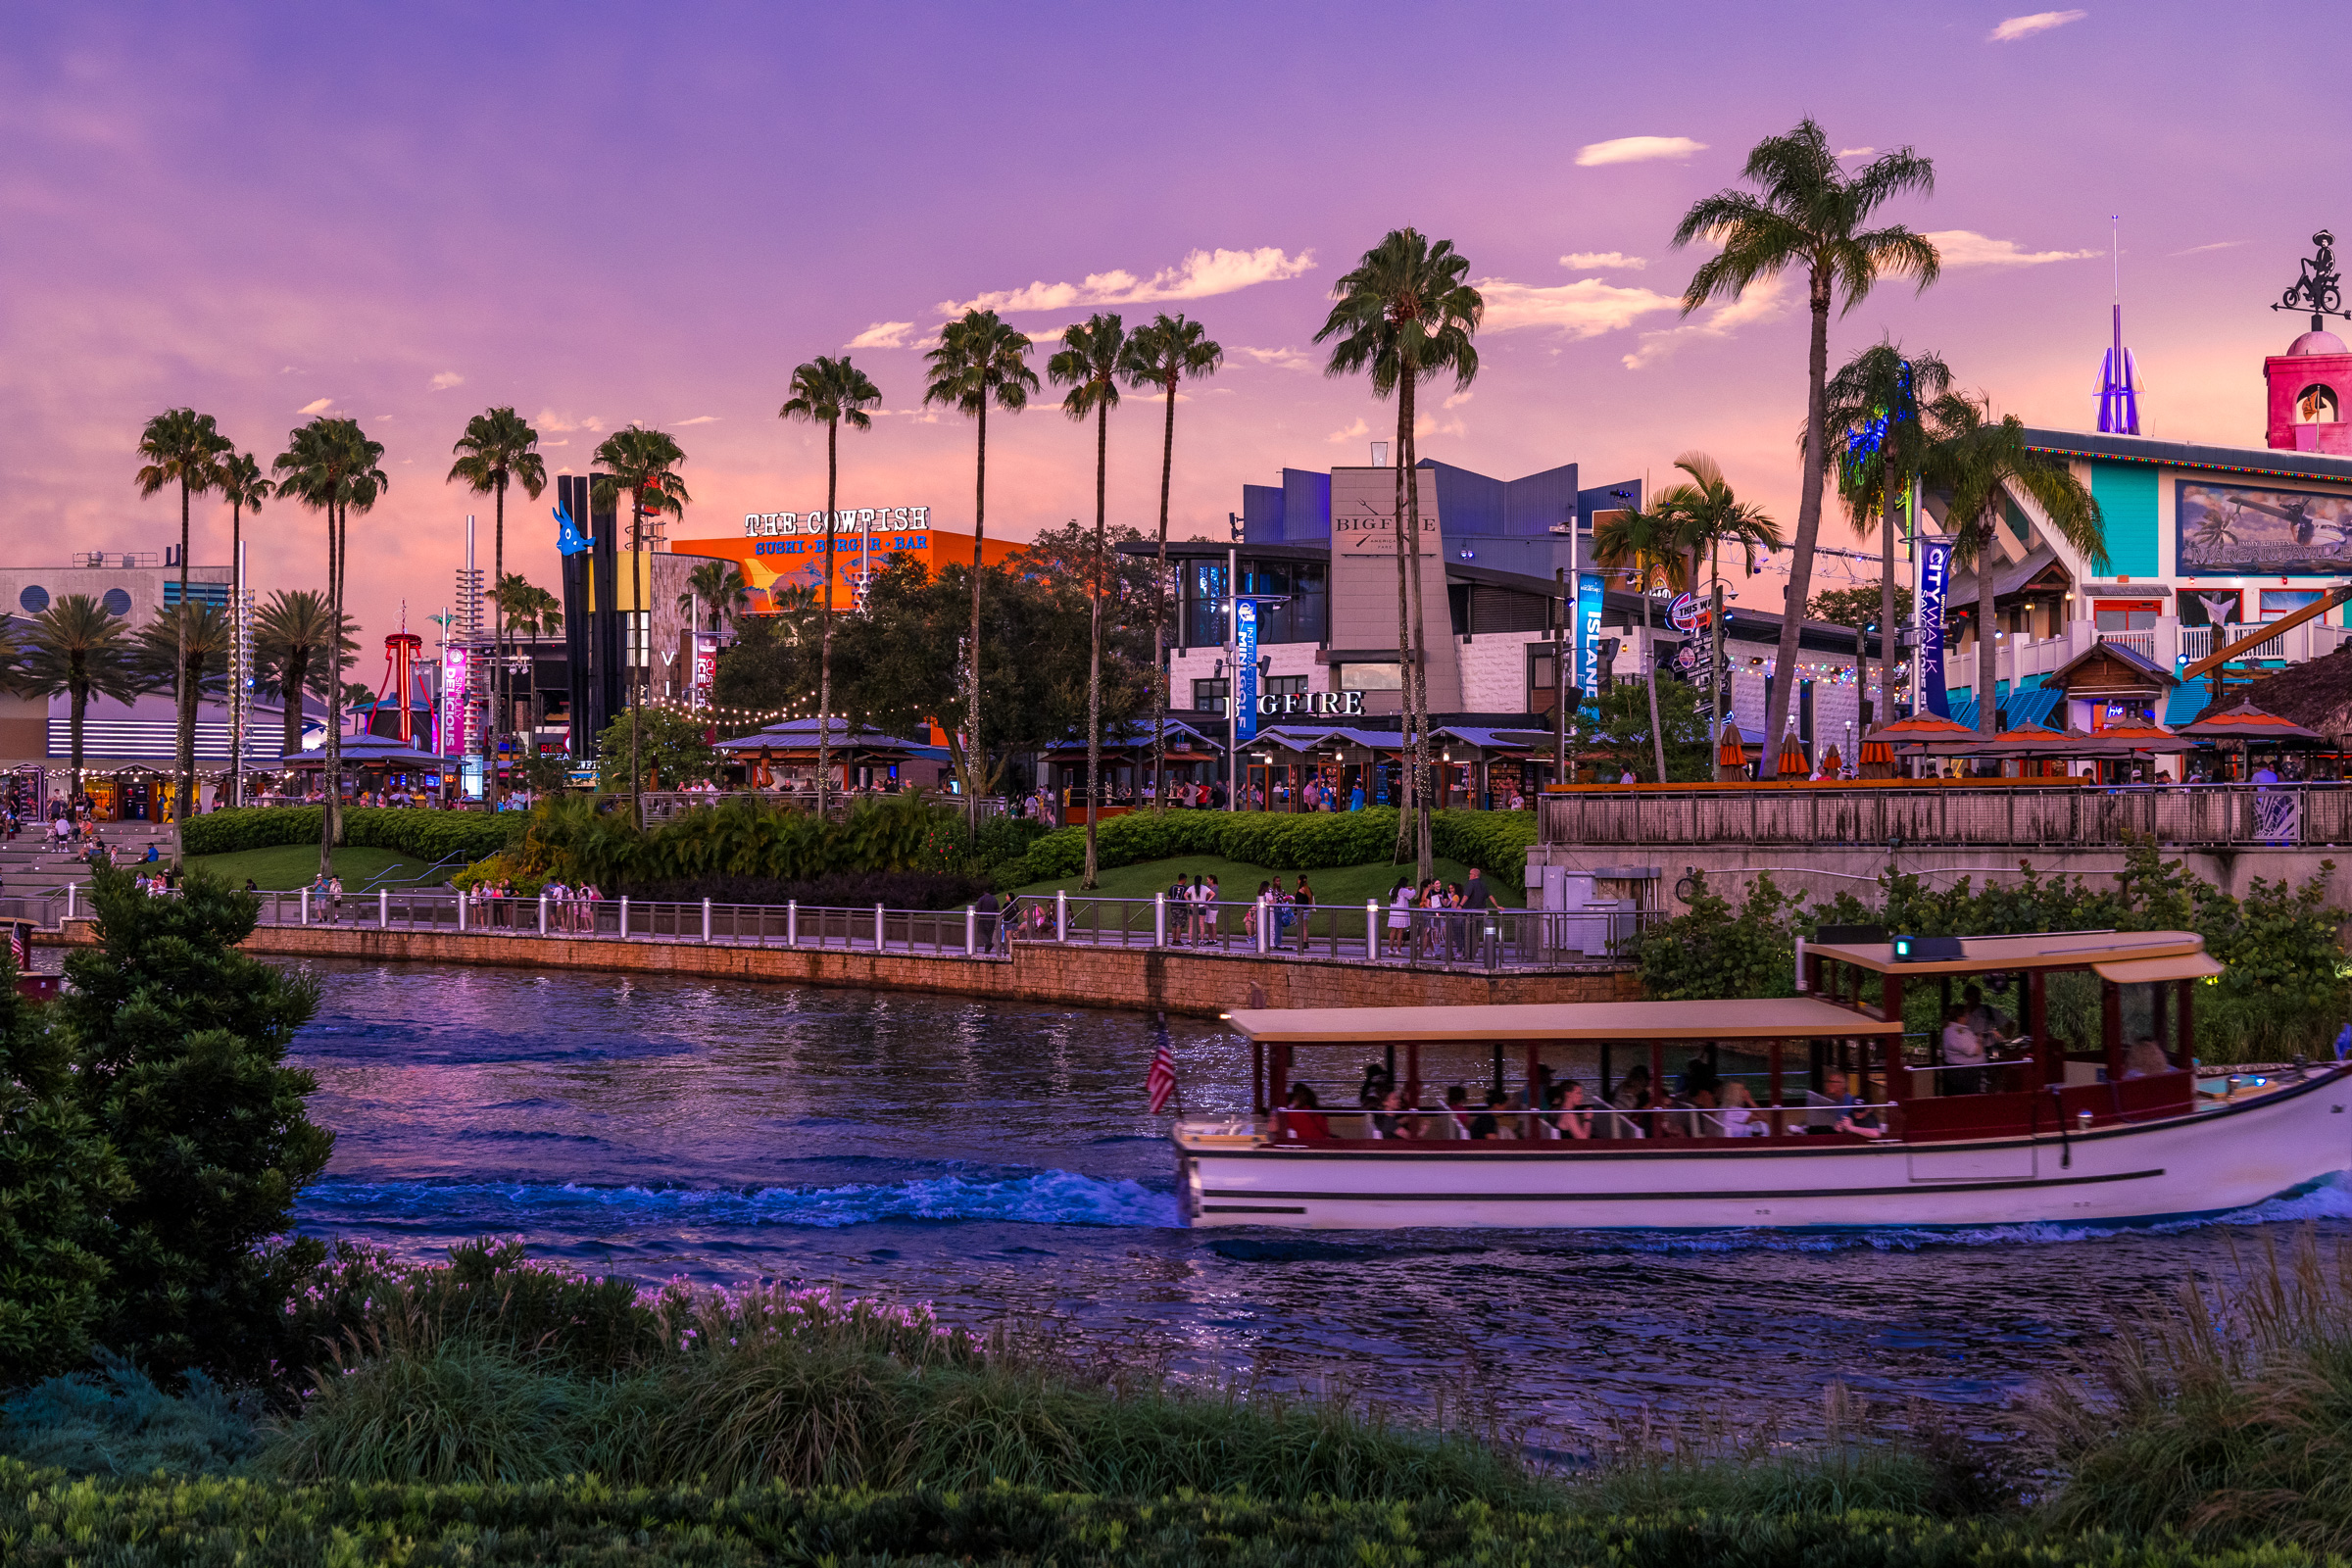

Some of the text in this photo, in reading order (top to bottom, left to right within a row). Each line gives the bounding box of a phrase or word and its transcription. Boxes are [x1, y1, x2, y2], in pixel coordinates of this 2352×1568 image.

[745, 506, 929, 537] THE COWFISH
[1335, 517, 1436, 532] BIGFE
[756, 535, 928, 556] SUSHI BRGR BAR
[2191, 544, 2351, 565] MARGARITAVILLE
[1680, 598, 1712, 617] THIS WA
[1238, 631, 1248, 671] MINI
[1246, 626, 1254, 701] INTERACTIVE
[697, 659, 707, 683] ICE
[445, 667, 457, 747] DELICIOUS
[1222, 691, 1362, 720] BGFIRE
[1237, 674, 1248, 728] GOLF
